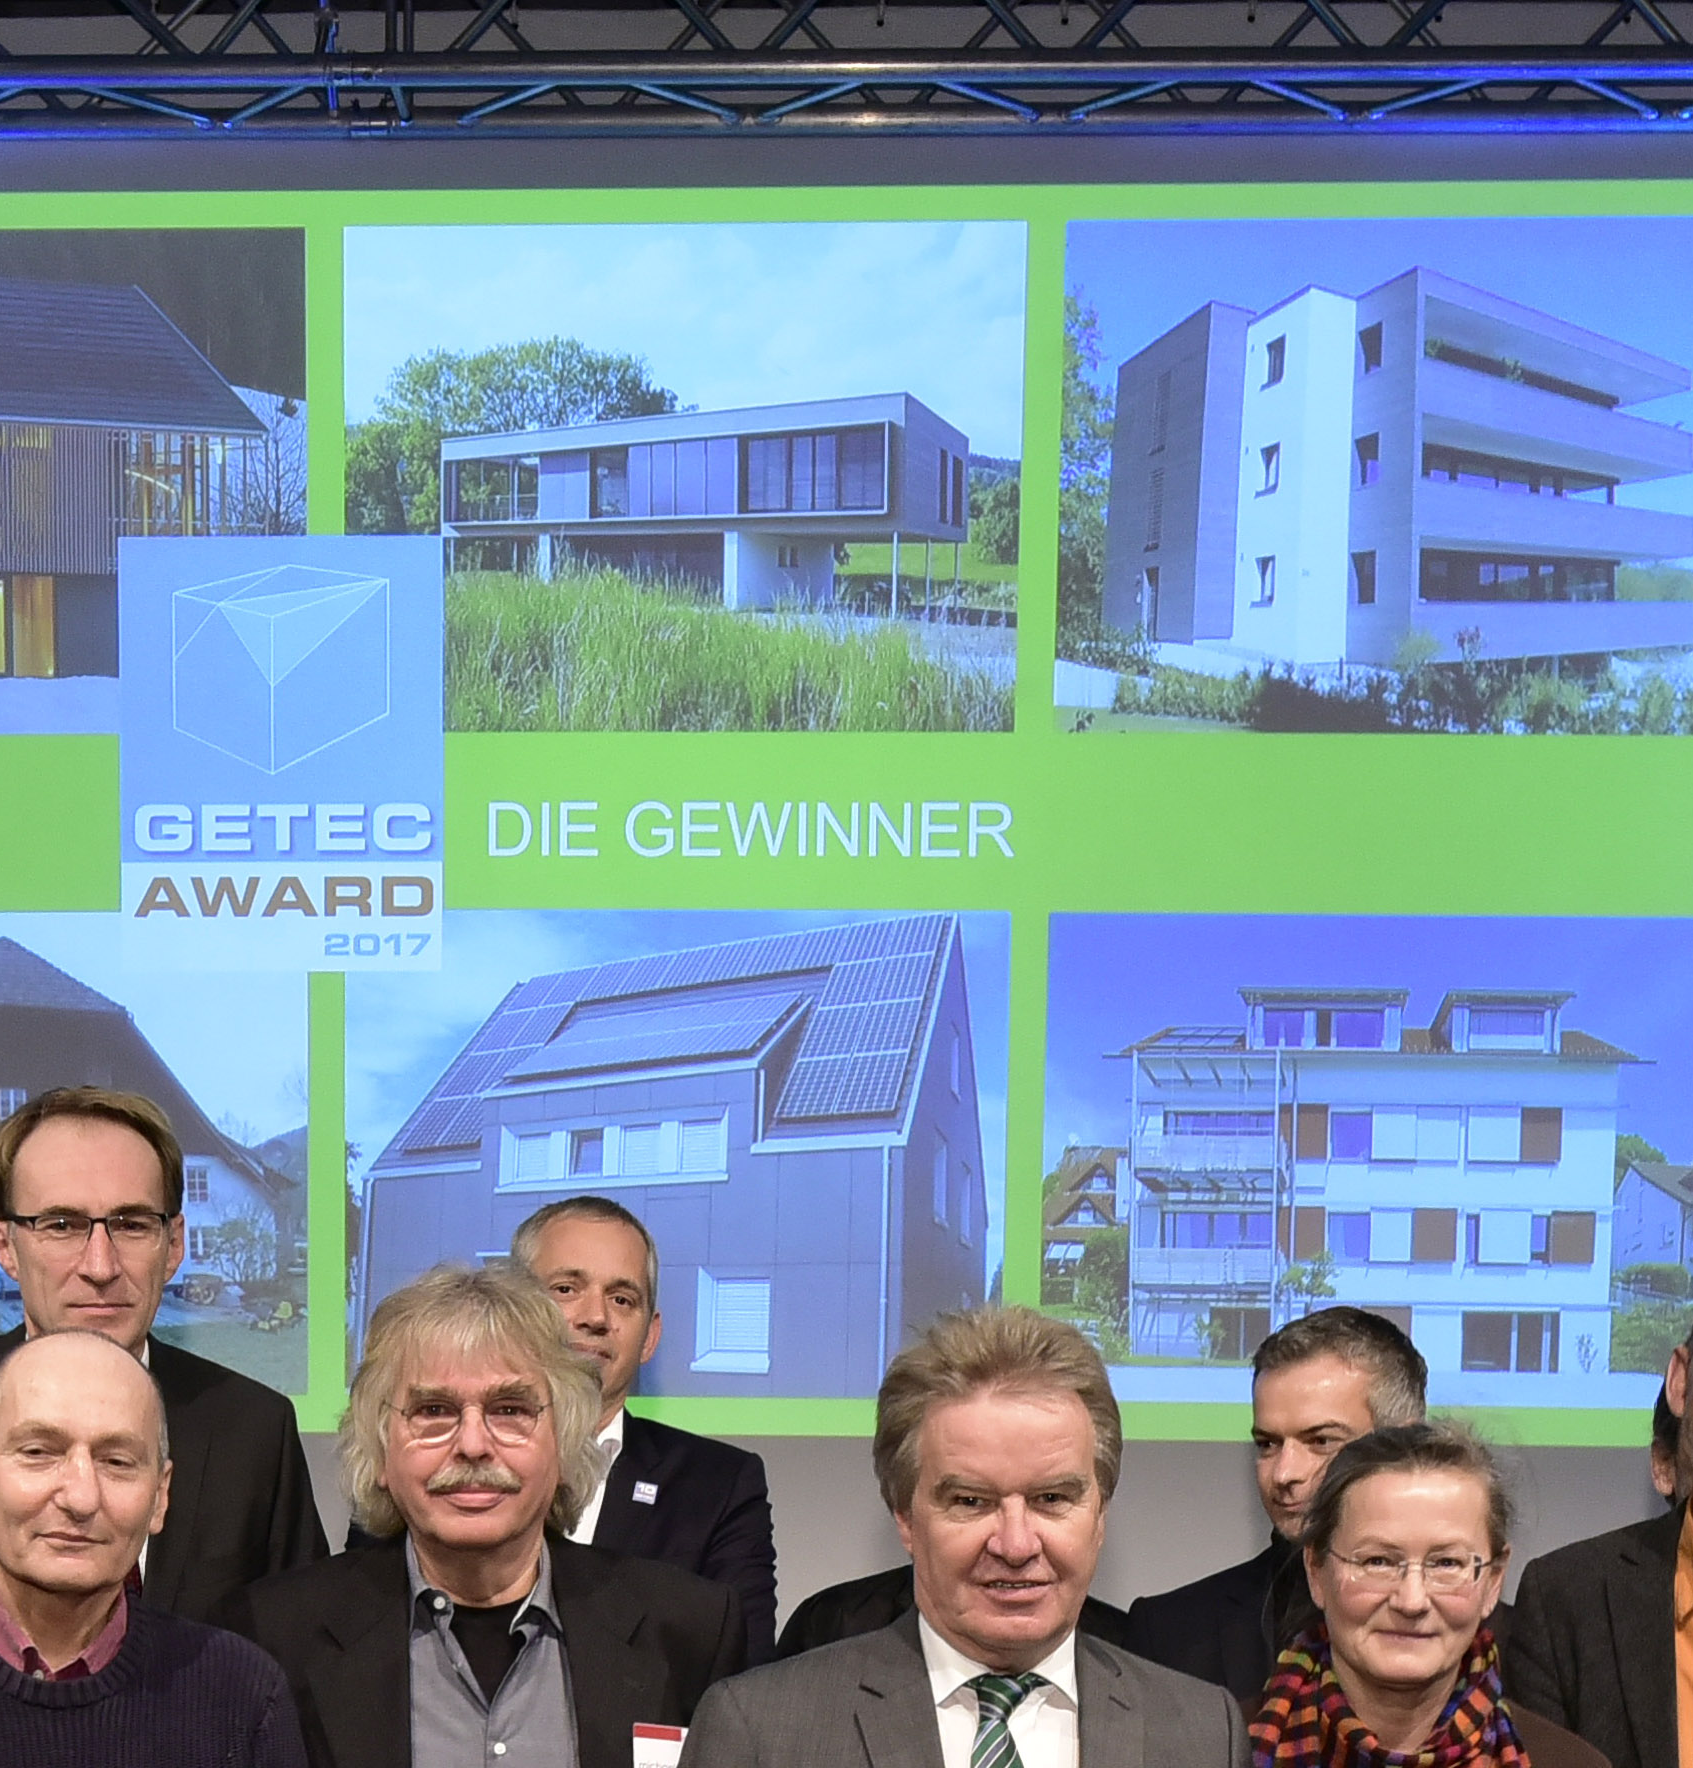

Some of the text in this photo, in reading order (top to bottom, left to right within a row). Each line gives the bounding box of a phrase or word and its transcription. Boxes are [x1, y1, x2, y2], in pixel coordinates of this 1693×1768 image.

[133, 803, 434, 854] GETEC
[488, 802, 1014, 859] DIE GEWINNER
[134, 876, 435, 918] AWARD
[323, 933, 431, 957] 2017
